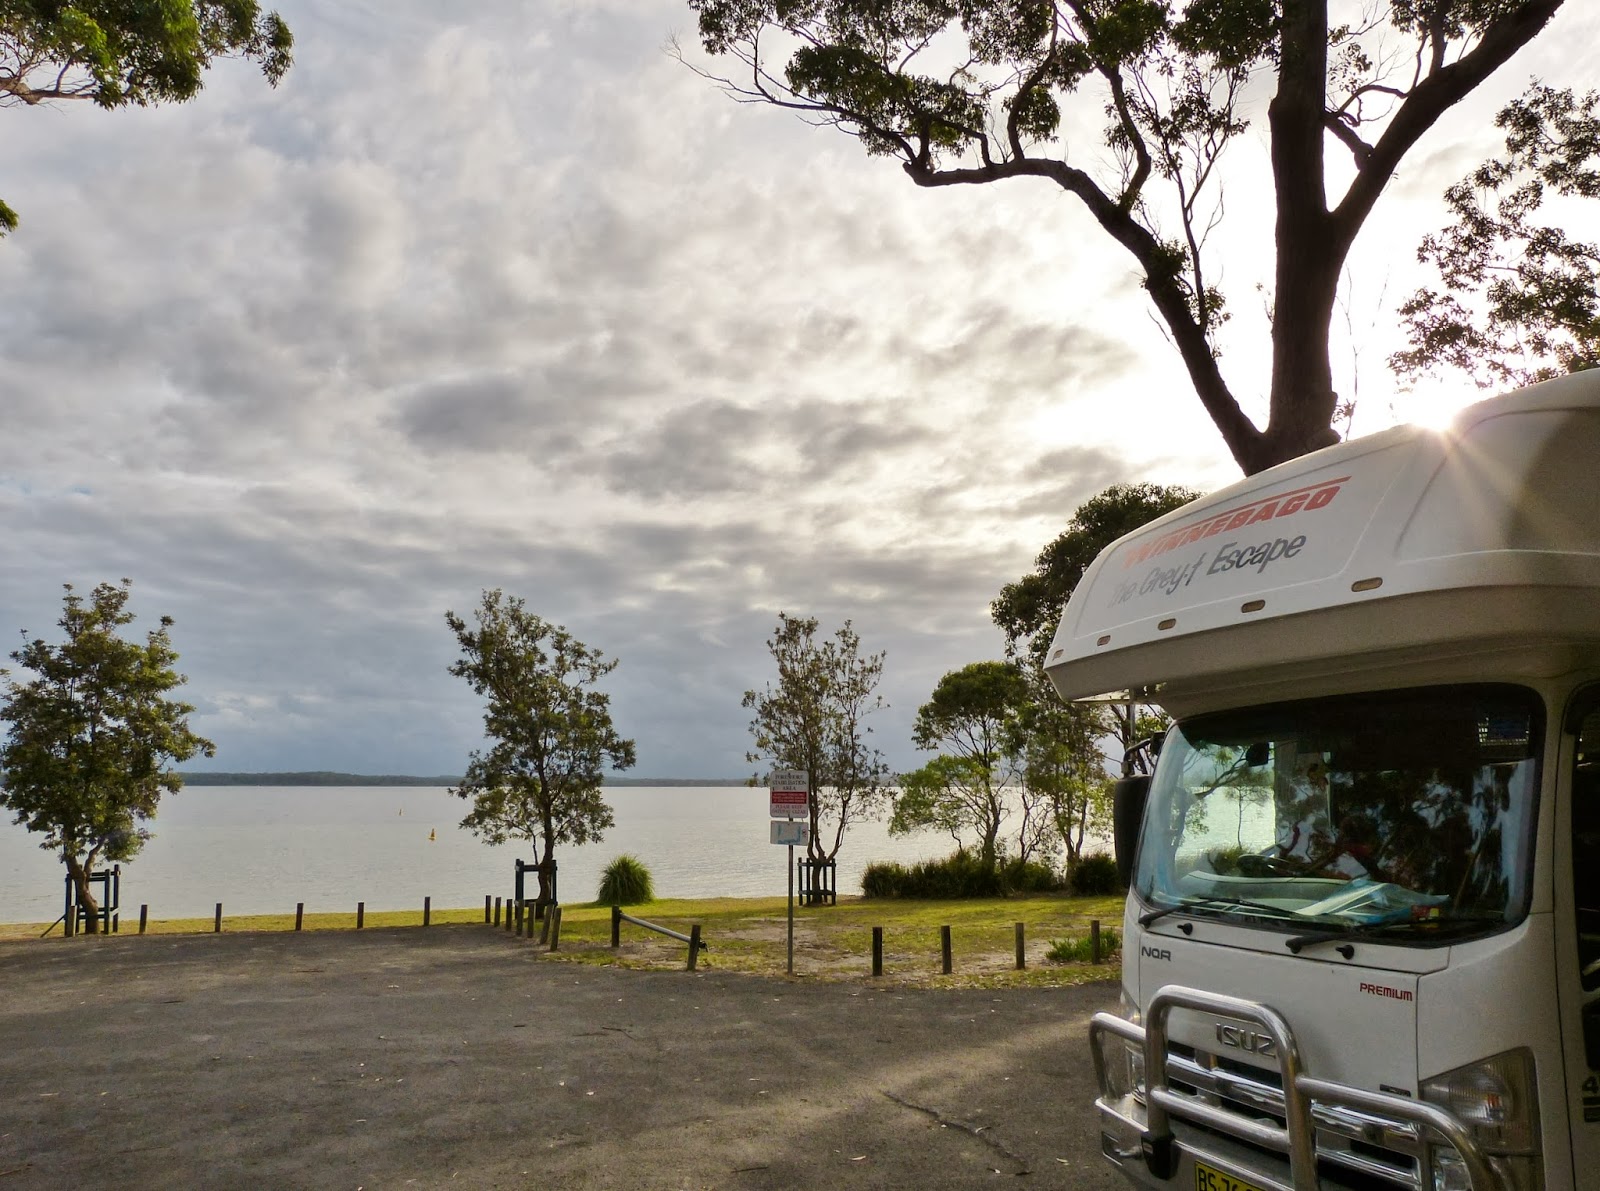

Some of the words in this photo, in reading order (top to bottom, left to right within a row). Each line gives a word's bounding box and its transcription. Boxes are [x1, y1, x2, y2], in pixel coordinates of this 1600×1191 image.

[1121, 484, 1342, 571] WINNEBAGO
[1206, 534, 1307, 576] Escape
[1359, 982, 1413, 1001] PREMIUM
[1216, 1023, 1277, 1060] ISUZ
